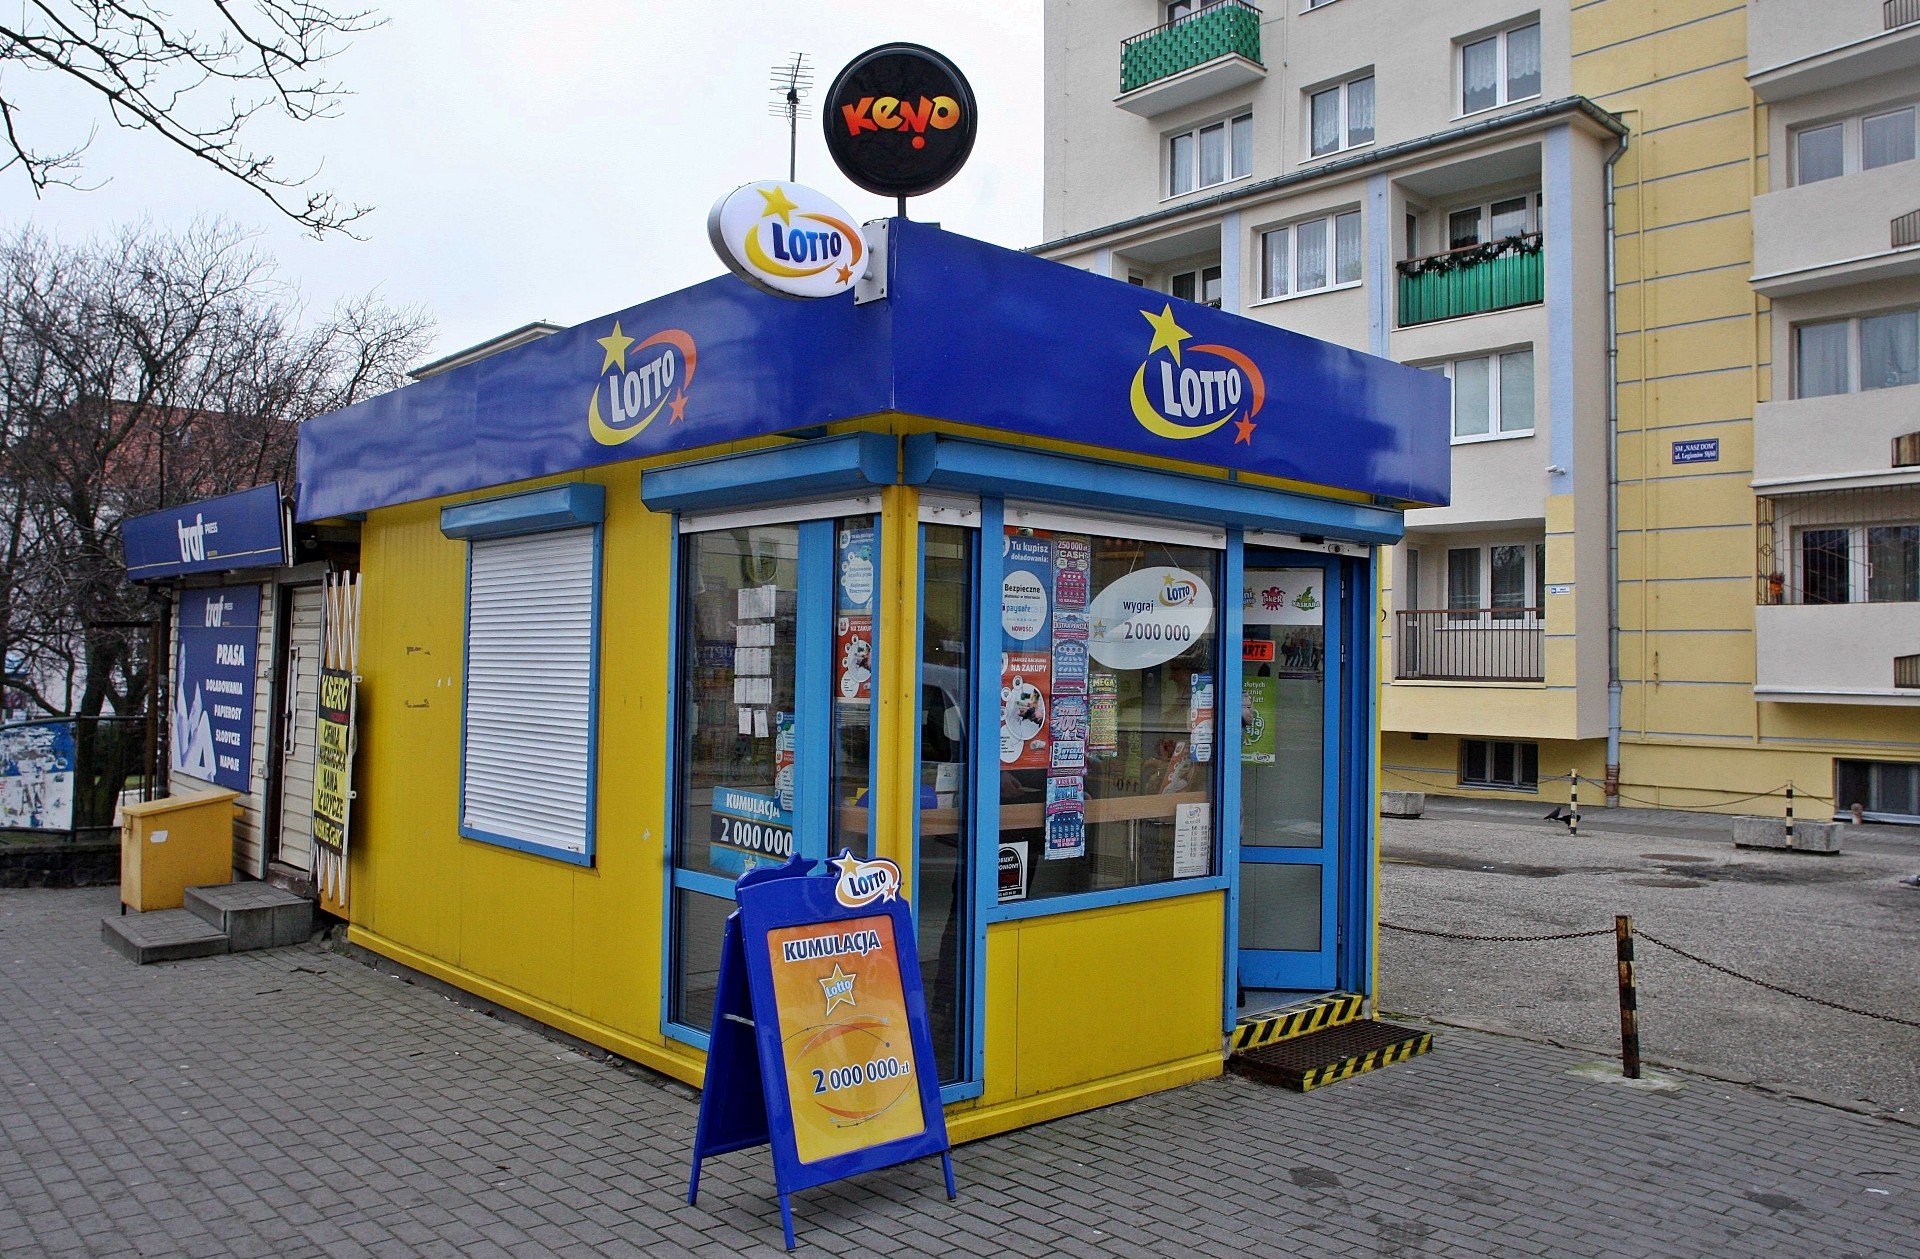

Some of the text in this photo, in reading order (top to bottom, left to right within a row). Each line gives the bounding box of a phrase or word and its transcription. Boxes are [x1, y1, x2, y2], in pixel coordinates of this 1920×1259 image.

[771, 222, 842, 263] LOTTO
[609, 349, 675, 423] LOTTO
[1160, 360, 1242, 419] LOTTO
[178, 513, 204, 563] traf
[1011, 541, 1049, 554] Tu kupisz
[1010, 553, 1049, 563] doładowania:
[1060, 551, 1085, 560] CASH
[1004, 583, 1041, 593] Bezpieczne
[1166, 585, 1190, 600] LOTTO
[205, 595, 224, 628] traf
[1123, 600, 1154, 614] wygraj
[1124, 621, 1191, 642] 2 000 000
[216, 643, 245, 667] PRASA
[1011, 664, 1047, 672] NA ZAKUPY
[1244, 682, 1266, 690] złotych
[213, 704, 242, 721] PAPIEROSY
[219, 754, 240, 772] NAPOJE
[726, 793, 780, 820] KUMULACJA
[720, 817, 793, 856] 2 000 000
[848, 870, 887, 896] LOTTO
[783, 930, 882, 962] KUMULACJA
[825, 980, 852, 998] Lotto
[812, 1057, 910, 1094] 2 000 000 zł
